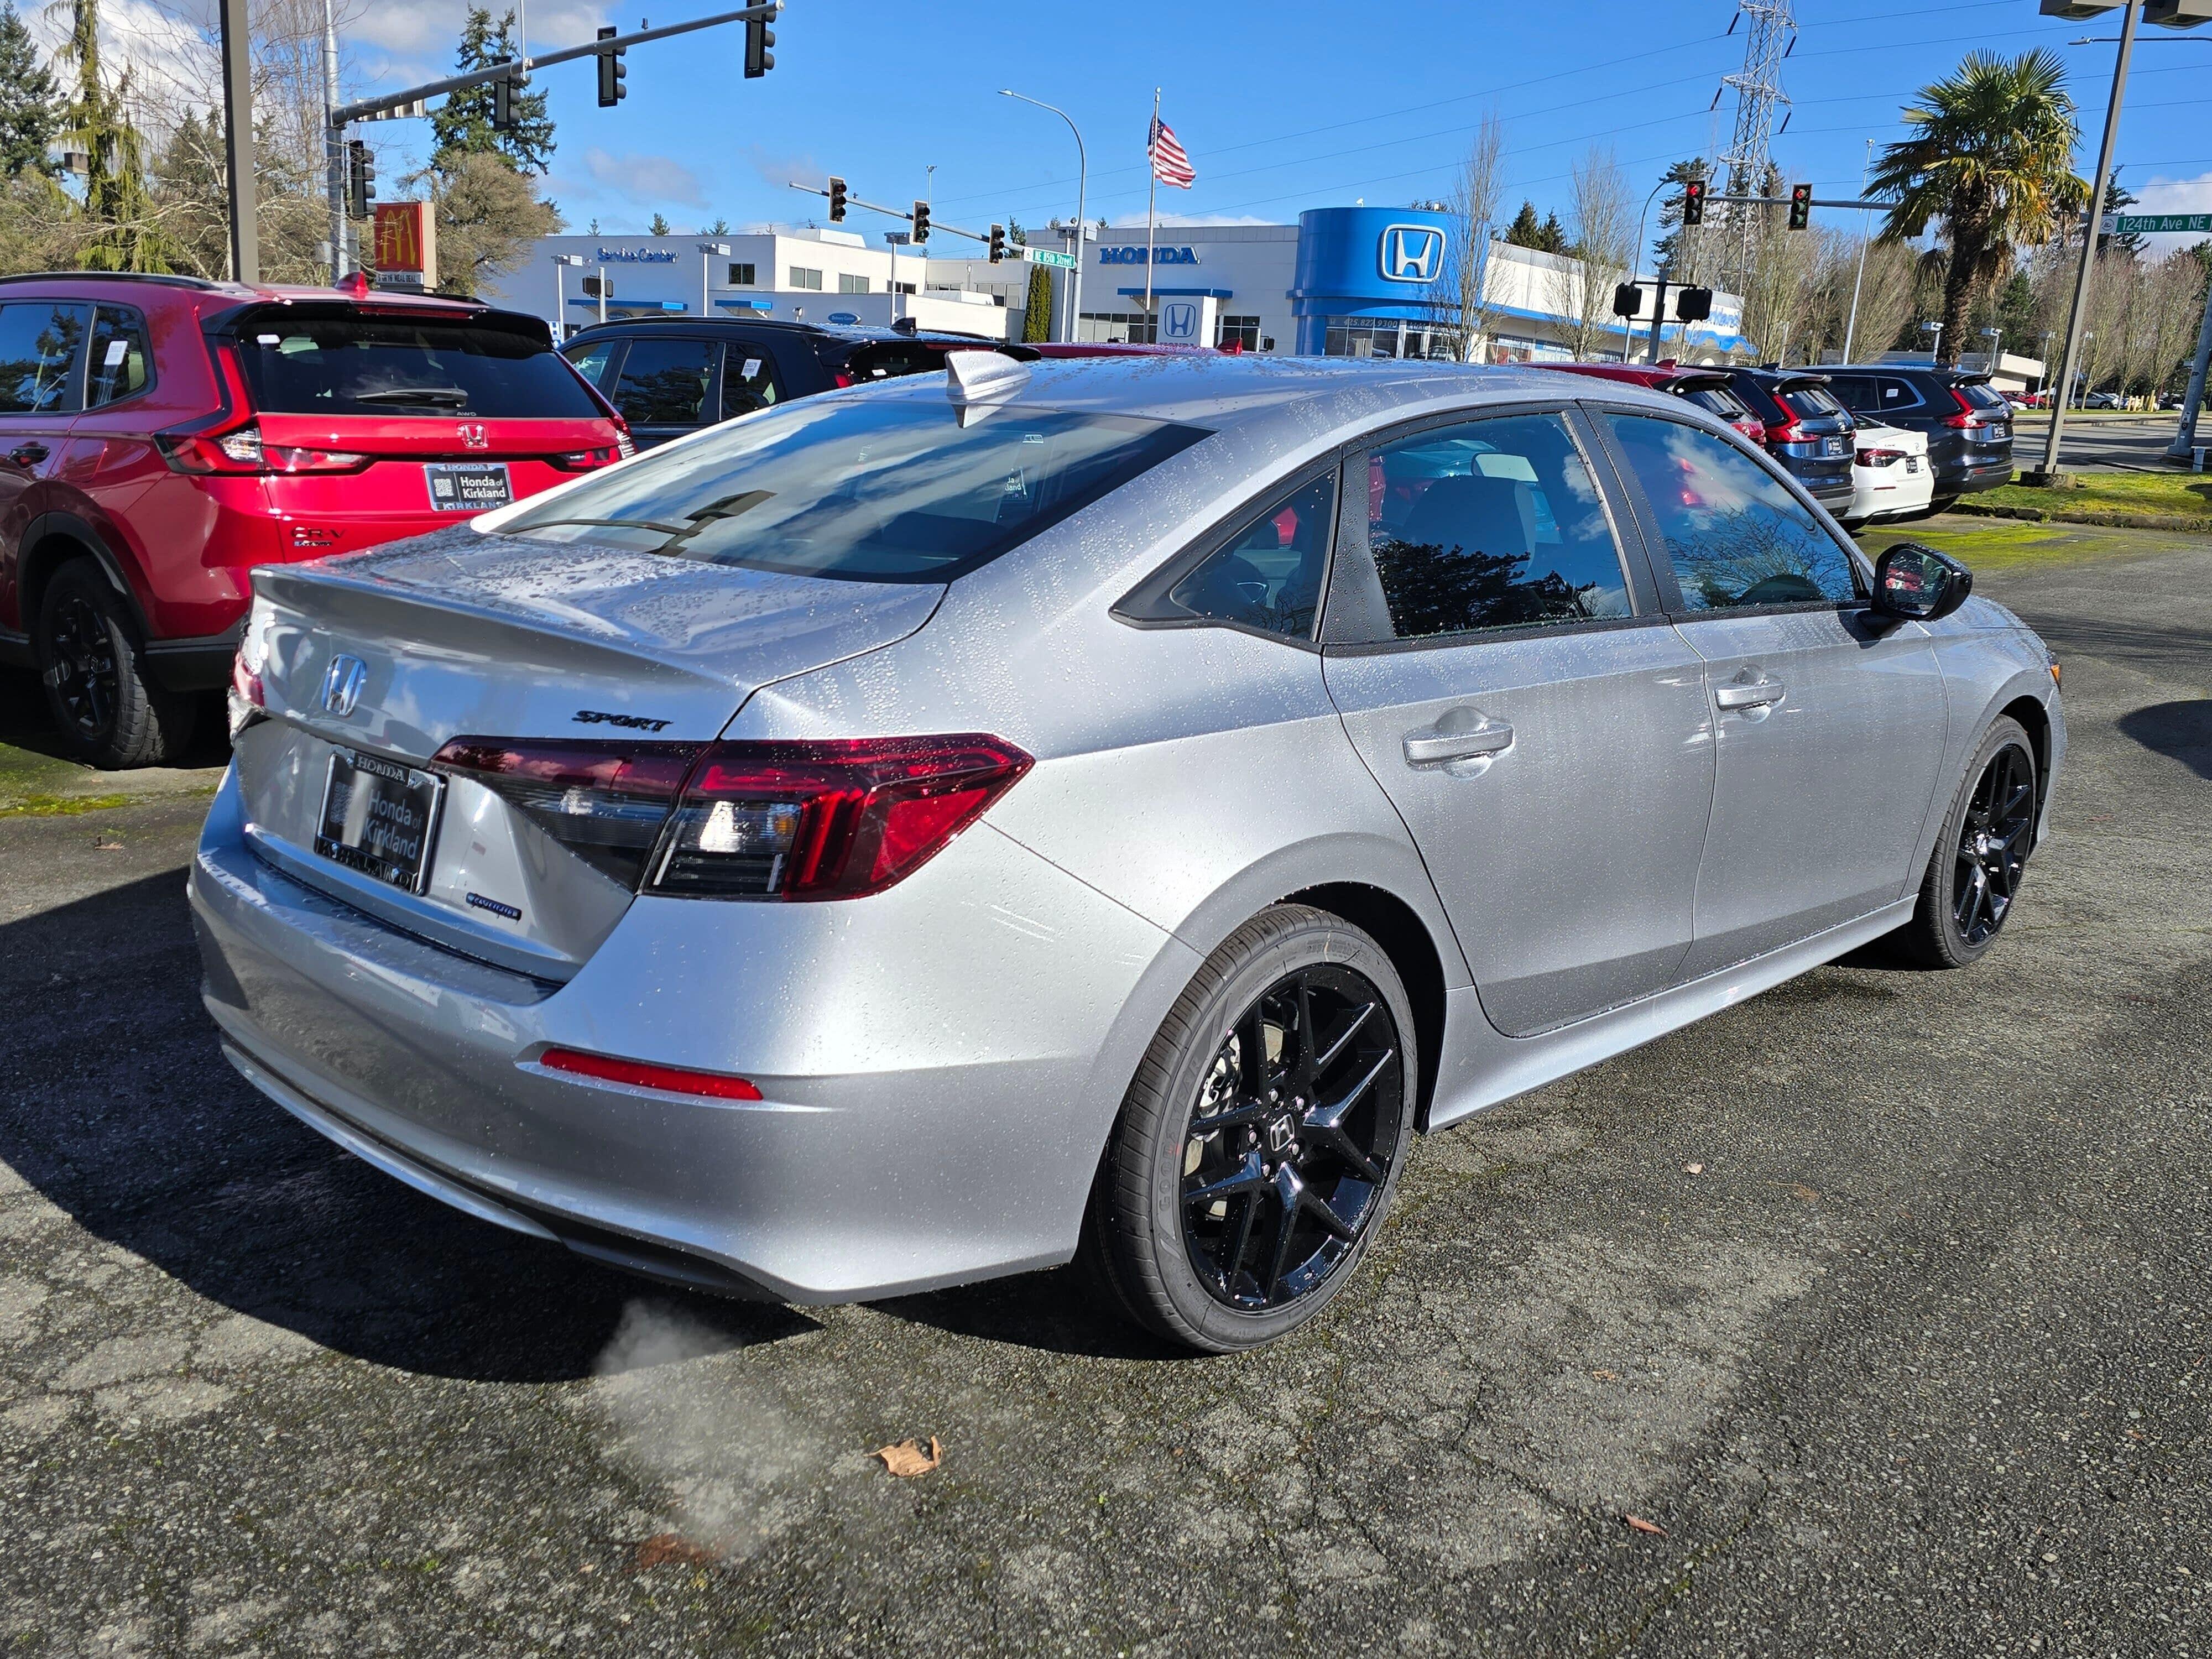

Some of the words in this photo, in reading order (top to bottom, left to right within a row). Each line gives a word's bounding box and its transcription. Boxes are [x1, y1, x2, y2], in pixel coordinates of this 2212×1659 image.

[2122, 217, 2156, 231] 124th
[2160, 217, 2182, 230] Ave
[2188, 216, 2206, 229] NE
[598, 247, 638, 262] Service
[639, 248, 679, 263] Center
[1035, 251, 1042, 261] NE
[1043, 252, 1055, 263] 85th
[1056, 254, 1072, 266] Street
[1099, 247, 1201, 264] HONDA
[460, 476, 495, 487] Honda
[463, 487, 507, 498] Kirkland
[571, 710, 674, 733] SPORT
[357, 756, 406, 782] HONDA
[368, 788, 411, 826] Honda
[411, 813, 424, 830] of
[363, 817, 420, 860] Kirkland
[1159, 1056, 1203, 1212] GOODYEAR
